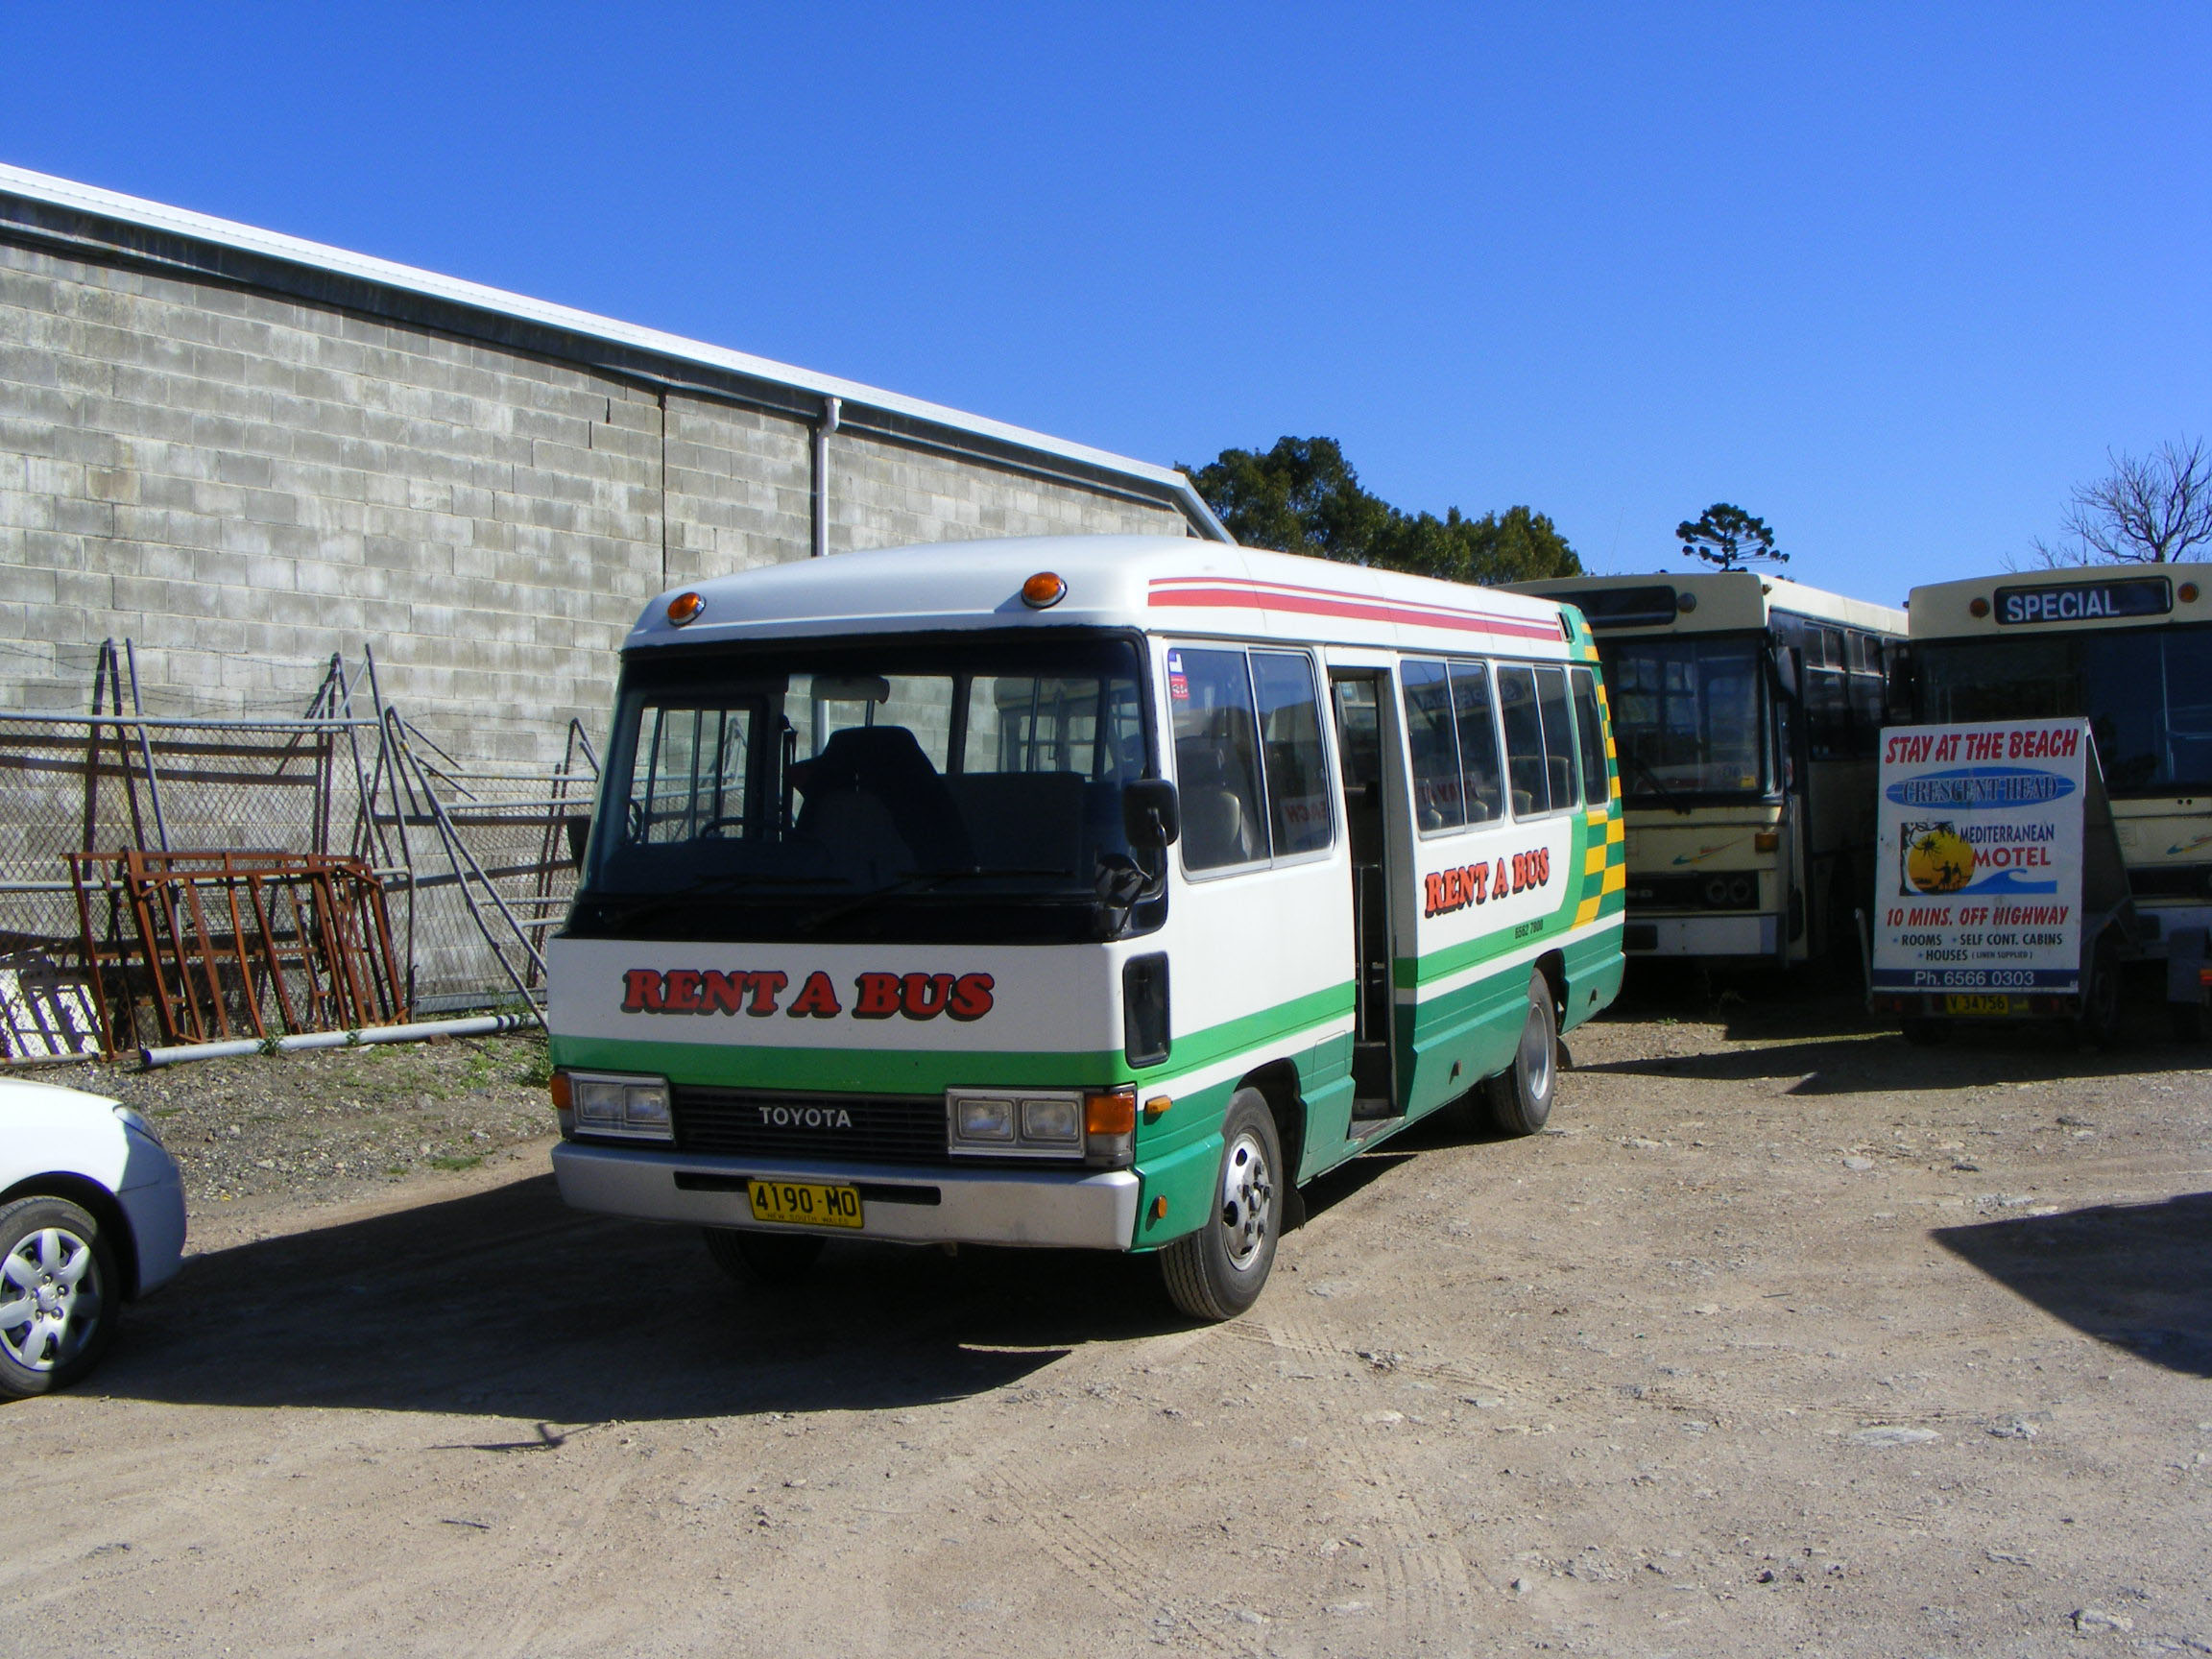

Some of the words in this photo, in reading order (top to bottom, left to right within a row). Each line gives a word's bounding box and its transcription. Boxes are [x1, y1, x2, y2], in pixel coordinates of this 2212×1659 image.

[2007, 589, 2120, 622] SPECIAL
[1885, 734, 1934, 764] STAY
[1936, 733, 1961, 762] AT
[1965, 732, 2005, 760] THE
[2008, 728, 2080, 759] BEACH
[1902, 776, 2001, 804] CRESCENT
[2005, 773, 2059, 801] HEAD
[1959, 823, 2055, 844] MEDITERRANEAN
[1971, 847, 2052, 868] MOTEL
[1425, 861, 1489, 919] RENT
[1492, 857, 1508, 901] A
[1512, 847, 1550, 894] BUS
[1886, 908, 1904, 926] 10
[1908, 907, 1953, 926] MINS.
[1959, 906, 1988, 926] OFF
[1992, 905, 2069, 926] HIGHWAY
[1901, 934, 1942, 946] ROOMS
[1960, 933, 1984, 946] SELF
[1986, 933, 2019, 946] CONT.
[2023, 933, 2063, 946] CABINS
[1926, 950, 1968, 961] HOUSES
[1914, 972, 1941, 986] Ph.
[1944, 971, 1986, 986] 6566
[1991, 971, 2034, 986] 0303
[620, 969, 788, 1017] RENT
[786, 971, 842, 1018] A
[852, 972, 995, 1022] BUS
[758, 1106, 852, 1128] TOYOTA
